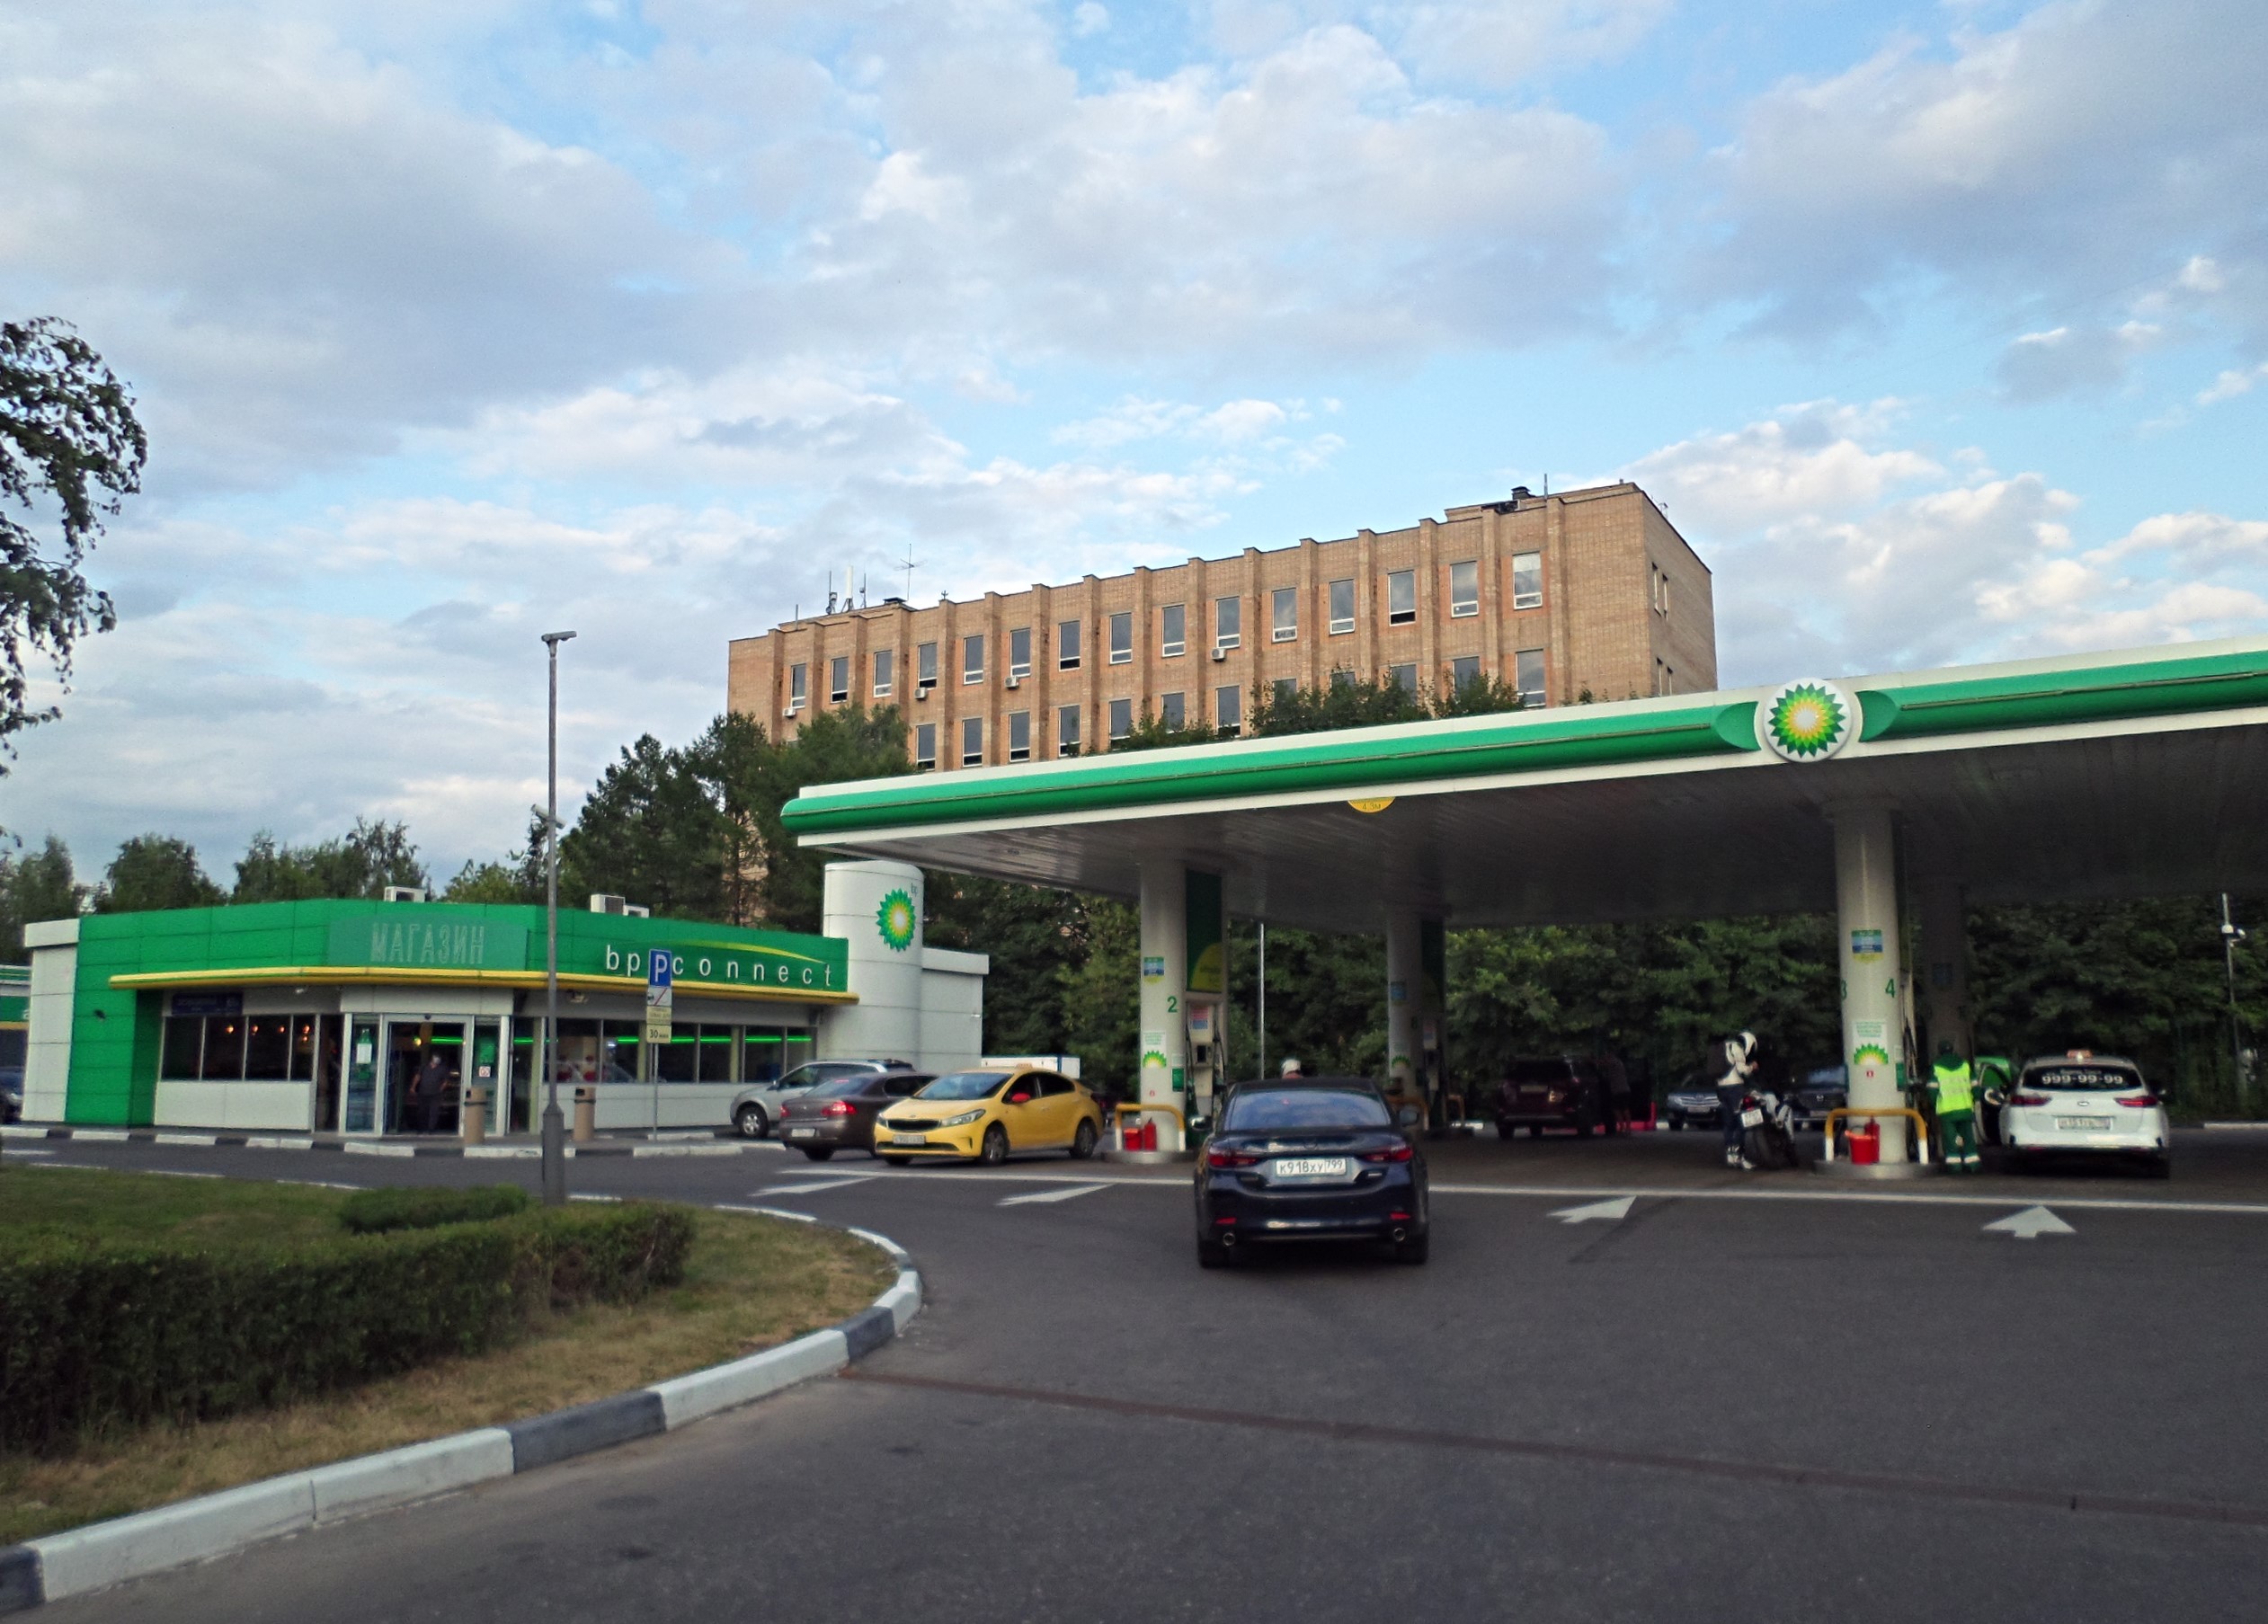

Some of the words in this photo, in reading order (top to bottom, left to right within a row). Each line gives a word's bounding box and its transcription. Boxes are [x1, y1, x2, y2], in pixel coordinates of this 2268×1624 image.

[370, 922, 485, 964] МАГАЗИН
[606, 945, 641, 978] bp
[672, 956, 832, 987] connect
[1885, 979, 1896, 998] 4
[1167, 996, 1178, 1013] 2
[649, 1029, 659, 1039] 30
[2042, 1074, 2123, 1085] 999-99-99
